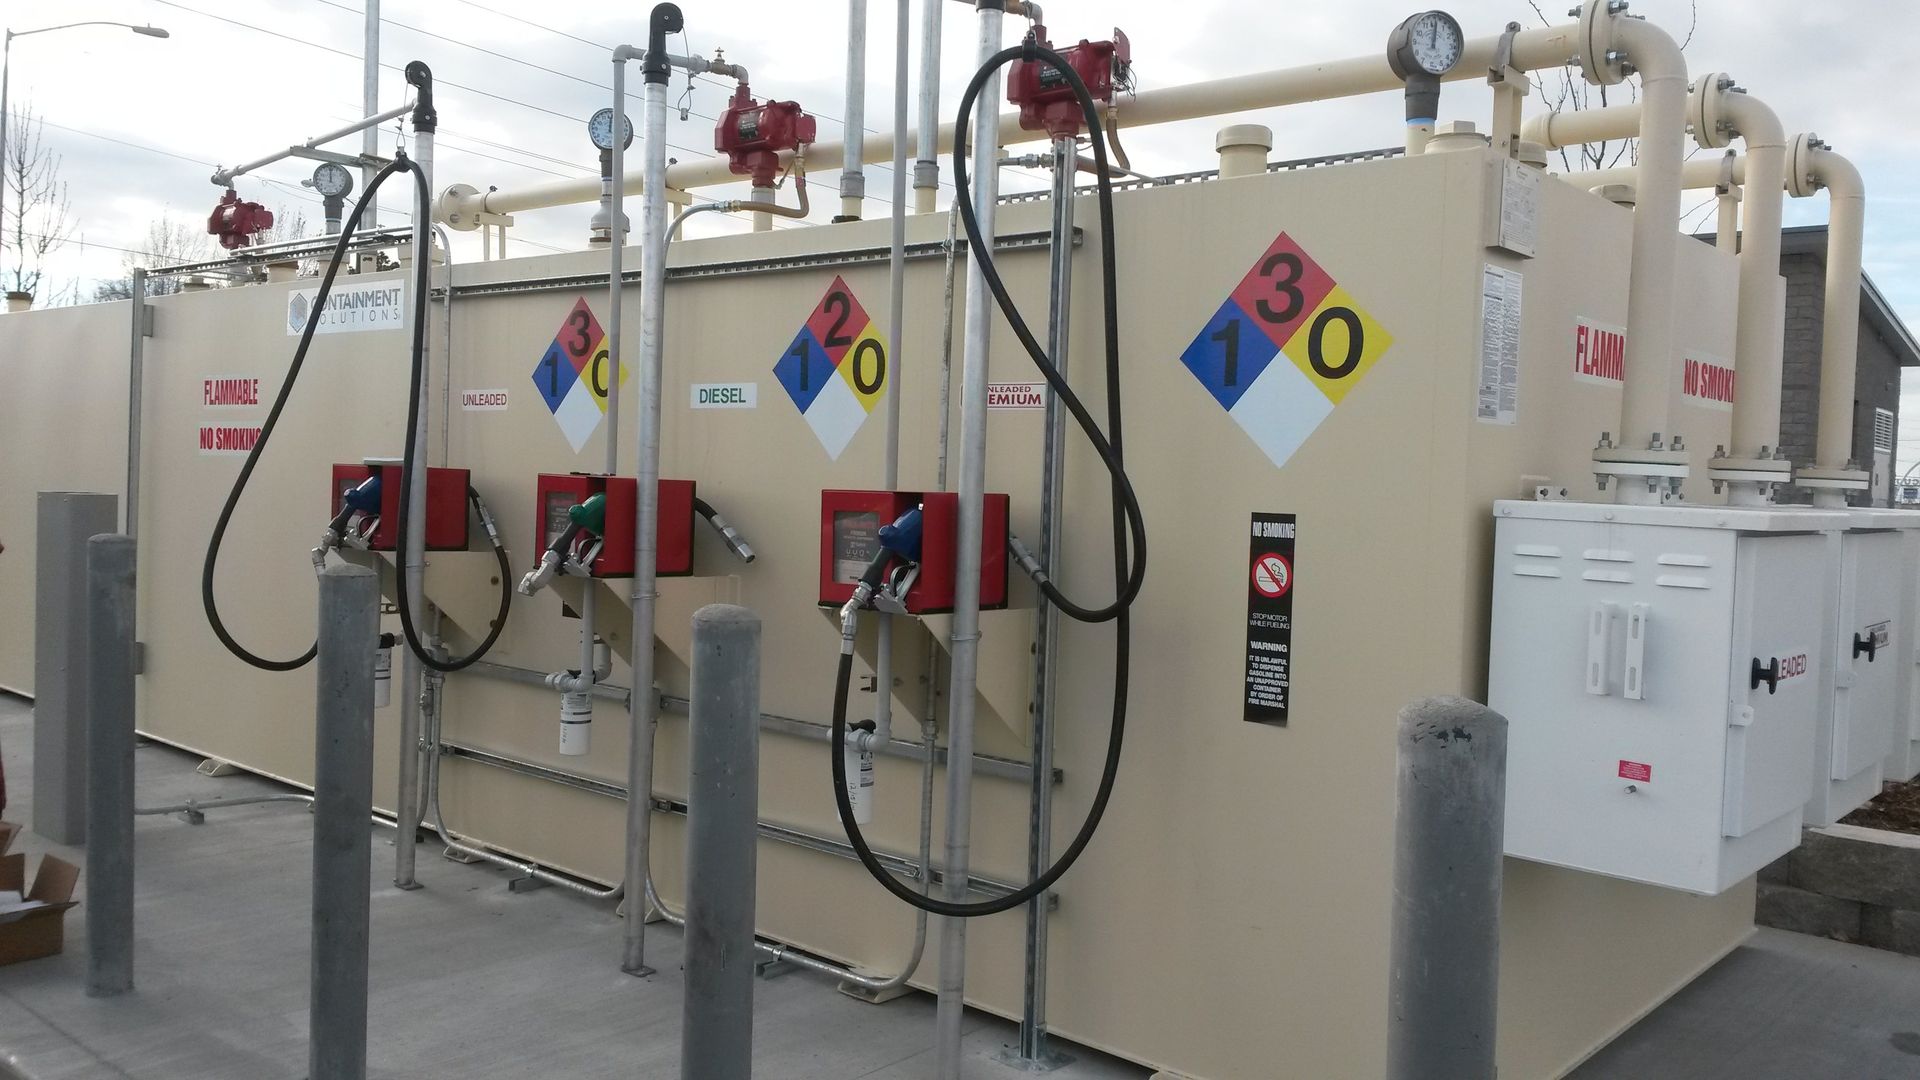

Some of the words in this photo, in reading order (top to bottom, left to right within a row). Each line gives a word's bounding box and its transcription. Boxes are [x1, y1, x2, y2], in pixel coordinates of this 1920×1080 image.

[1255, 252, 1305, 324] 3
[319, 308, 399, 325] OLUTIONS
[823, 291, 852, 348] 2
[568, 309, 591, 357] 3
[1307, 306, 1365, 380] 0
[1211, 318, 1241, 387] 1
[1575, 324, 1625, 382] FLAMM
[791, 338, 810, 392] 1
[852, 338, 886, 395] 0
[544, 351, 559, 398] 1
[1683, 358, 1699, 397] NO
[1700, 362, 1735, 404] SMOKI
[204, 379, 258, 406] FLAMMABLE
[699, 388, 746, 404] DIESEL
[988, 385, 1032, 393] NLEADED
[462, 393, 507, 407] UNLEADED
[988, 393, 1042, 406] EMIUM
[200, 427, 213, 450] NO
[1252, 521, 1262, 537] NO
[1263, 521, 1295, 539] SMOKING
[1250, 619, 1266, 627] WHILE
[1267, 621, 1290, 630] FUELING
[1252, 612, 1266, 620] STOP
[1250, 641, 1287, 652] WARNING
[1260, 656, 1287, 665] UNLAWFUL
[1260, 664, 1284, 672] DISPENSE
[1776, 653, 1807, 681] LEADED
[1249, 669, 1273, 678] GASOLINE
[1254, 677, 1288, 687] UNAPPROVED
[1250, 690, 1257, 698] BY
[1257, 692, 1275, 700] ORDER
[1276, 694, 1284, 702] OF
[1253, 684, 1281, 693] CONTAINER
[1248, 697, 1260, 705] FIRE
[1260, 699, 1286, 709] MARSHAL
